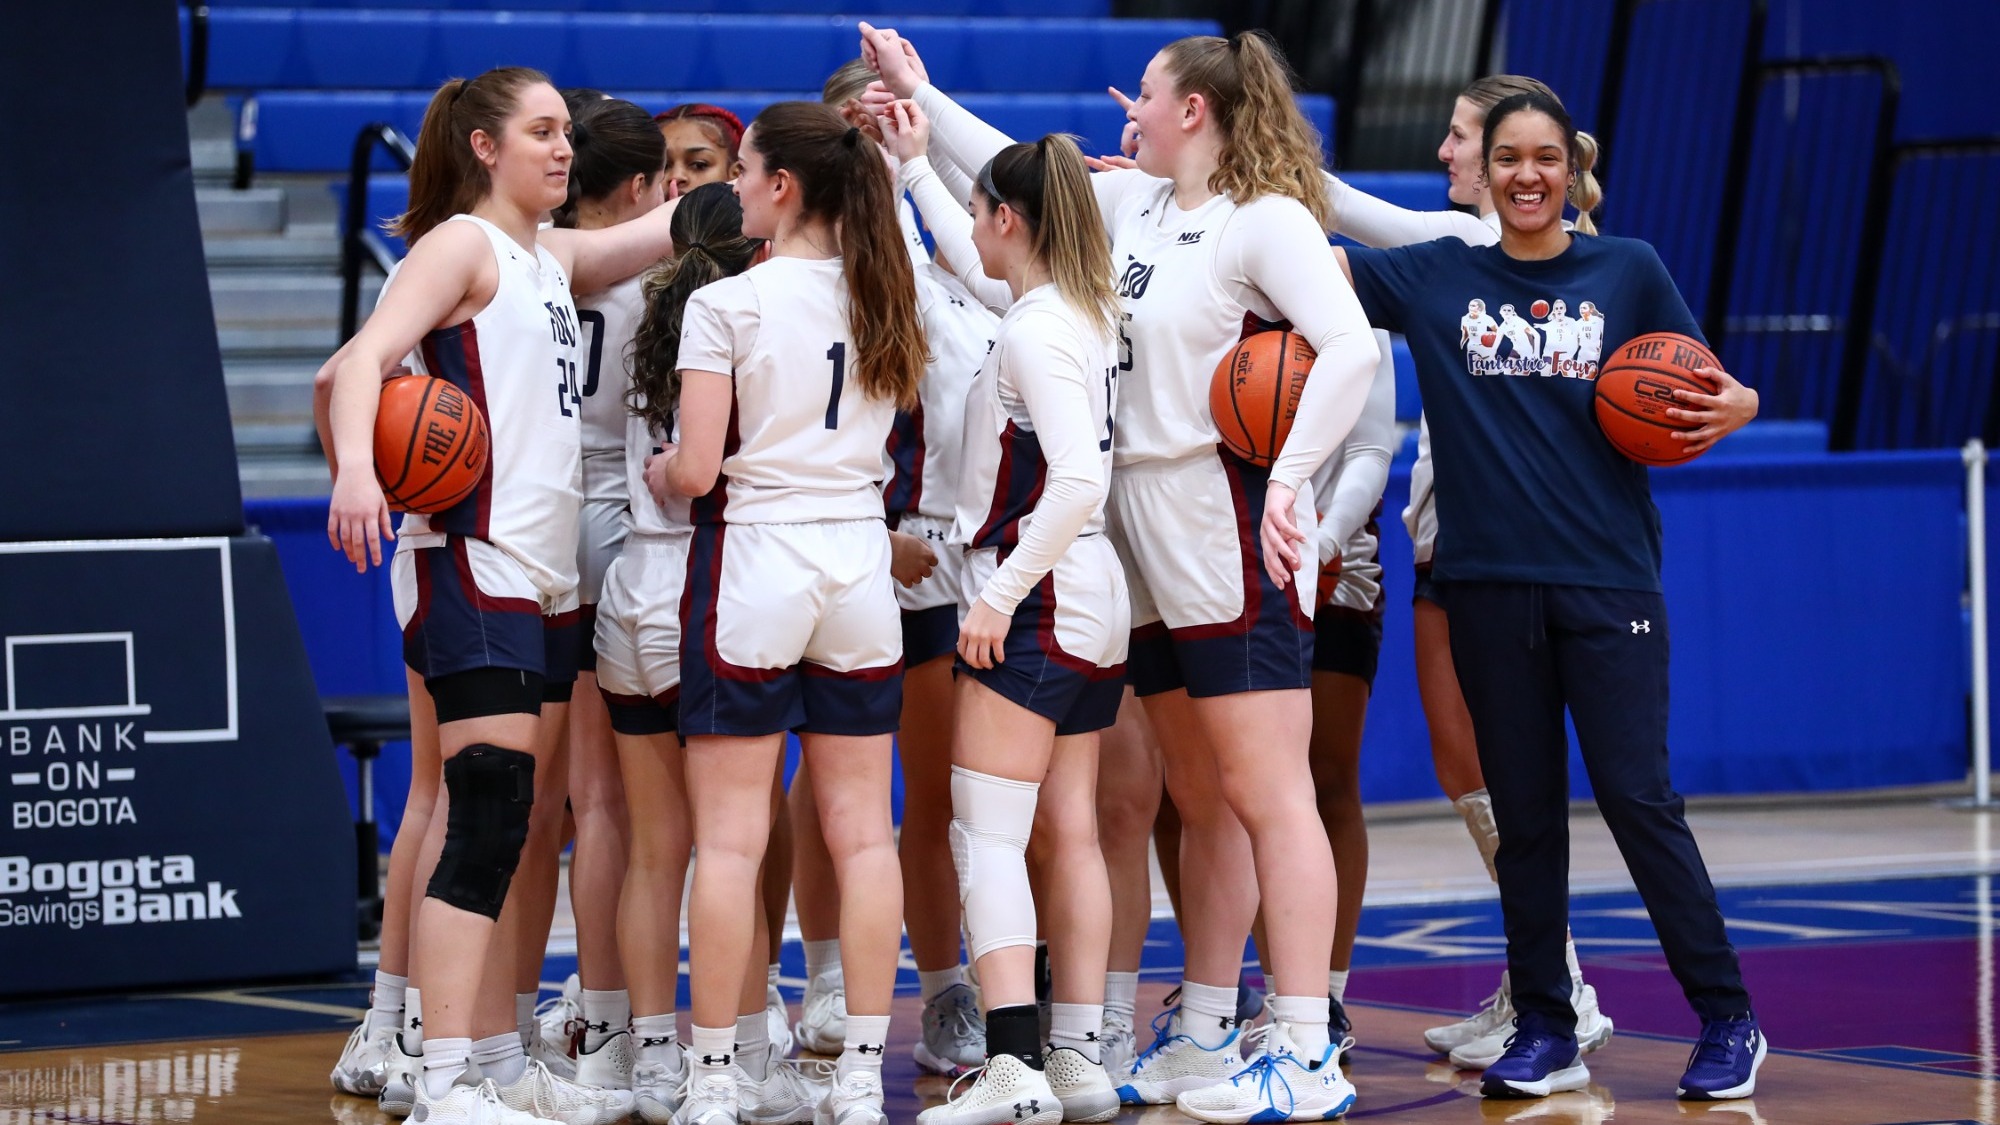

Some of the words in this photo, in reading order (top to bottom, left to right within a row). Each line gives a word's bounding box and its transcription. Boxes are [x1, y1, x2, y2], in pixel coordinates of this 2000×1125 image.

[1177, 230, 1205, 243] NEC
[1235, 351, 1250, 386] ROCK
[1468, 349, 1546, 373] Fantastic
[1551, 351, 1598, 375] Four
[1625, 341, 1666, 361] THE
[824, 341, 846, 431] 1
[422, 421, 457, 466] THE
[10, 721, 137, 756] BANK
[47, 760, 100, 791] ON
[12, 796, 137, 829] BOGOTA
[0, 854, 195, 900] Bogota
[0, 896, 100, 930] Savings
[102, 881, 242, 926] Bank
